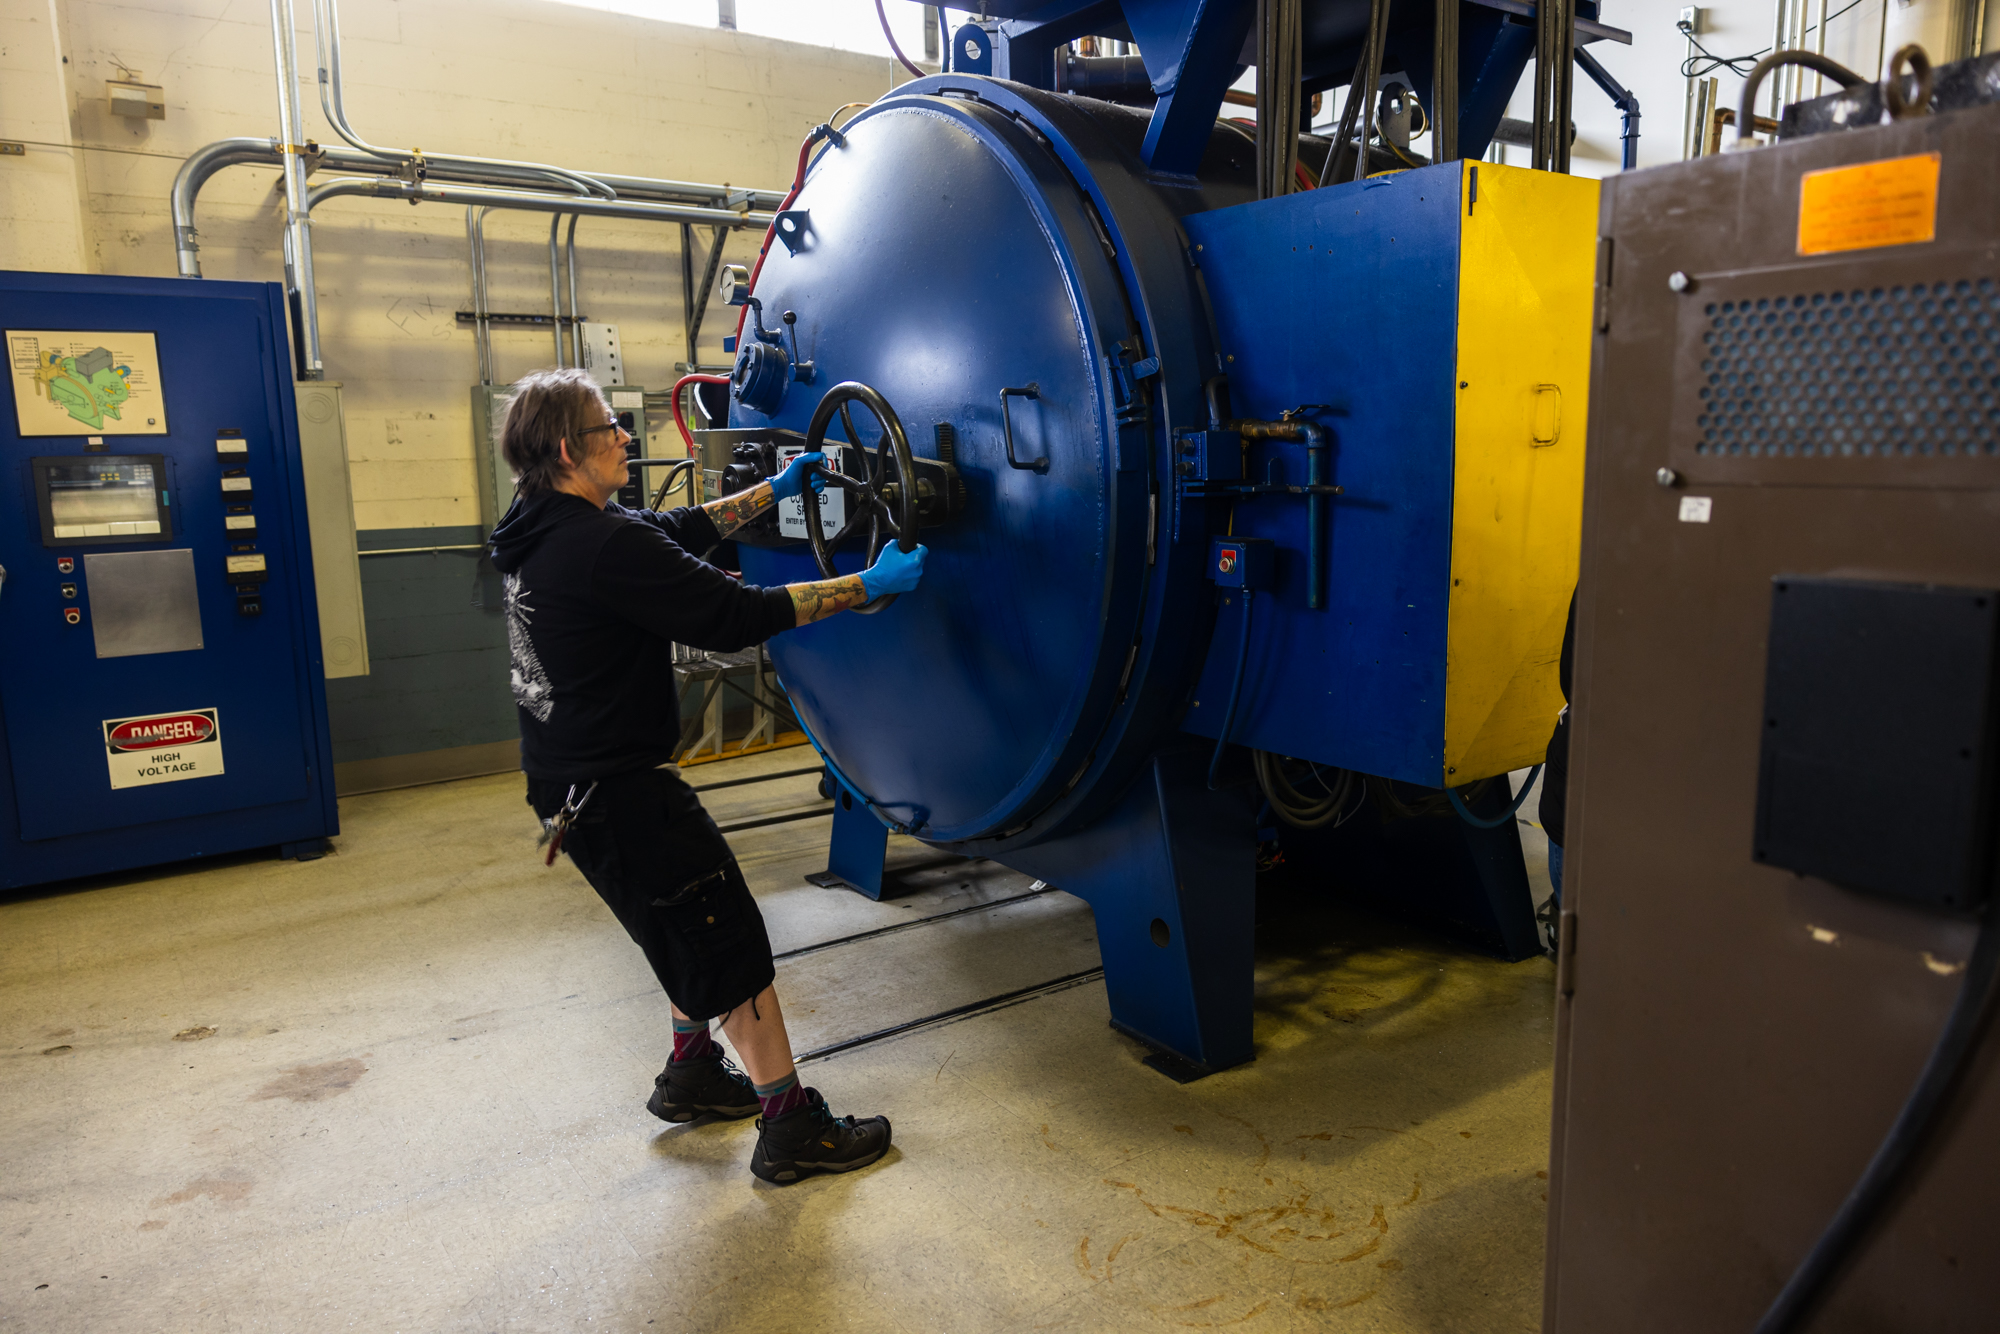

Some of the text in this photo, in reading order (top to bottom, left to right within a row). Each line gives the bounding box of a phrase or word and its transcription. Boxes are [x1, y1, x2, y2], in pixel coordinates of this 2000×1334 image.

[785, 517, 799, 525] ENTER
[823, 520, 836, 528] ONLY
[131, 721, 195, 742] DANGER
[152, 752, 181, 763] HIGH
[137, 762, 196, 777] VOLTAGE
